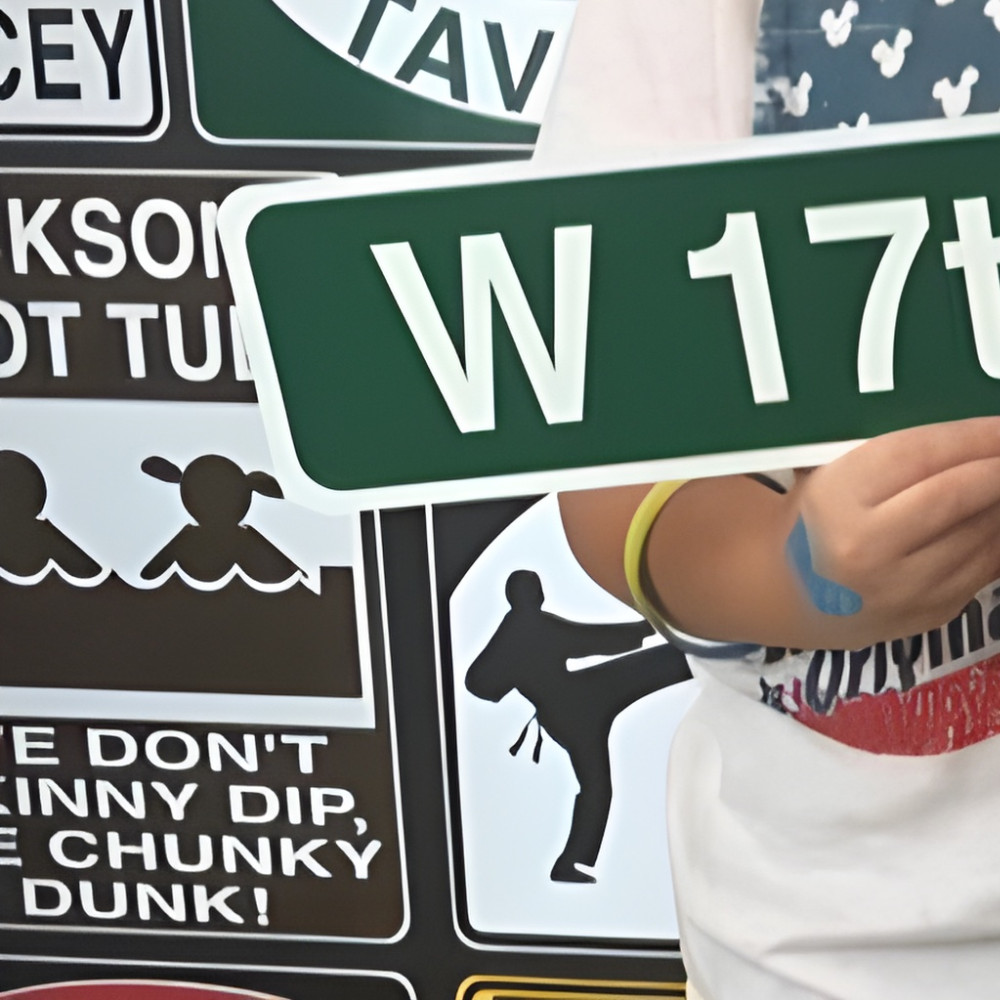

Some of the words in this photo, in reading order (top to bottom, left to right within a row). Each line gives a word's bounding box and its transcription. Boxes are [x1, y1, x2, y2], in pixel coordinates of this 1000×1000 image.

[370, 224, 593, 434] W
[0, 725, 60, 765] E
[87, 728, 328, 774] DON'T
[0, 775, 199, 821] INNY
[229, 785, 367, 836] DIP,
[49, 829, 382, 881] CHUNKY
[22, 876, 271, 926] DUNK!
